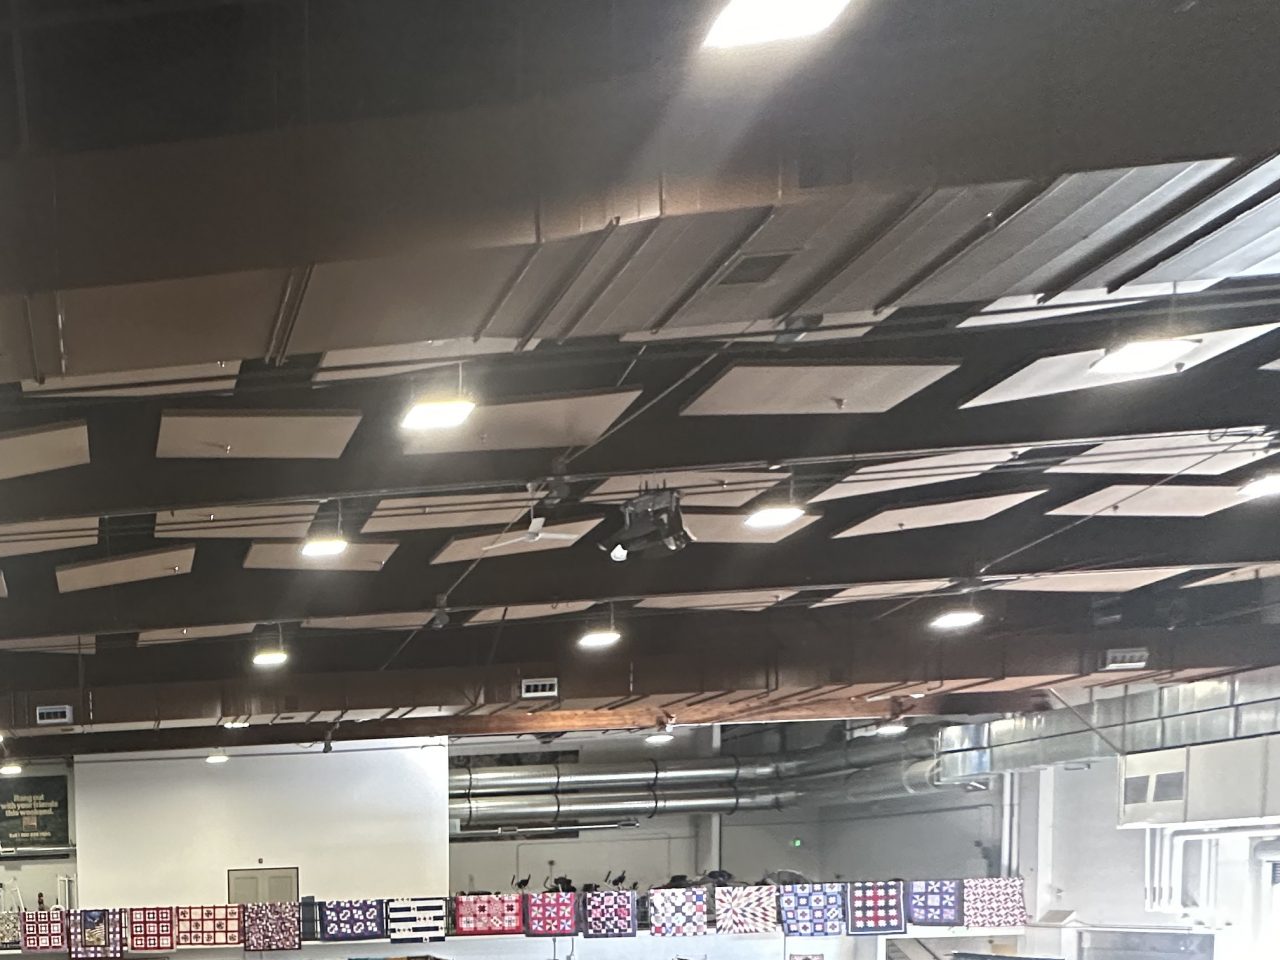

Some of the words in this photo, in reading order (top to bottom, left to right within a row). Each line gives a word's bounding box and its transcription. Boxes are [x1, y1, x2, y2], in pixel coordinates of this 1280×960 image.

[0, 801, 17, 810] with
[17, 802, 32, 811] your
[33, 800, 59, 809] friends
[5, 809, 19, 817] this
